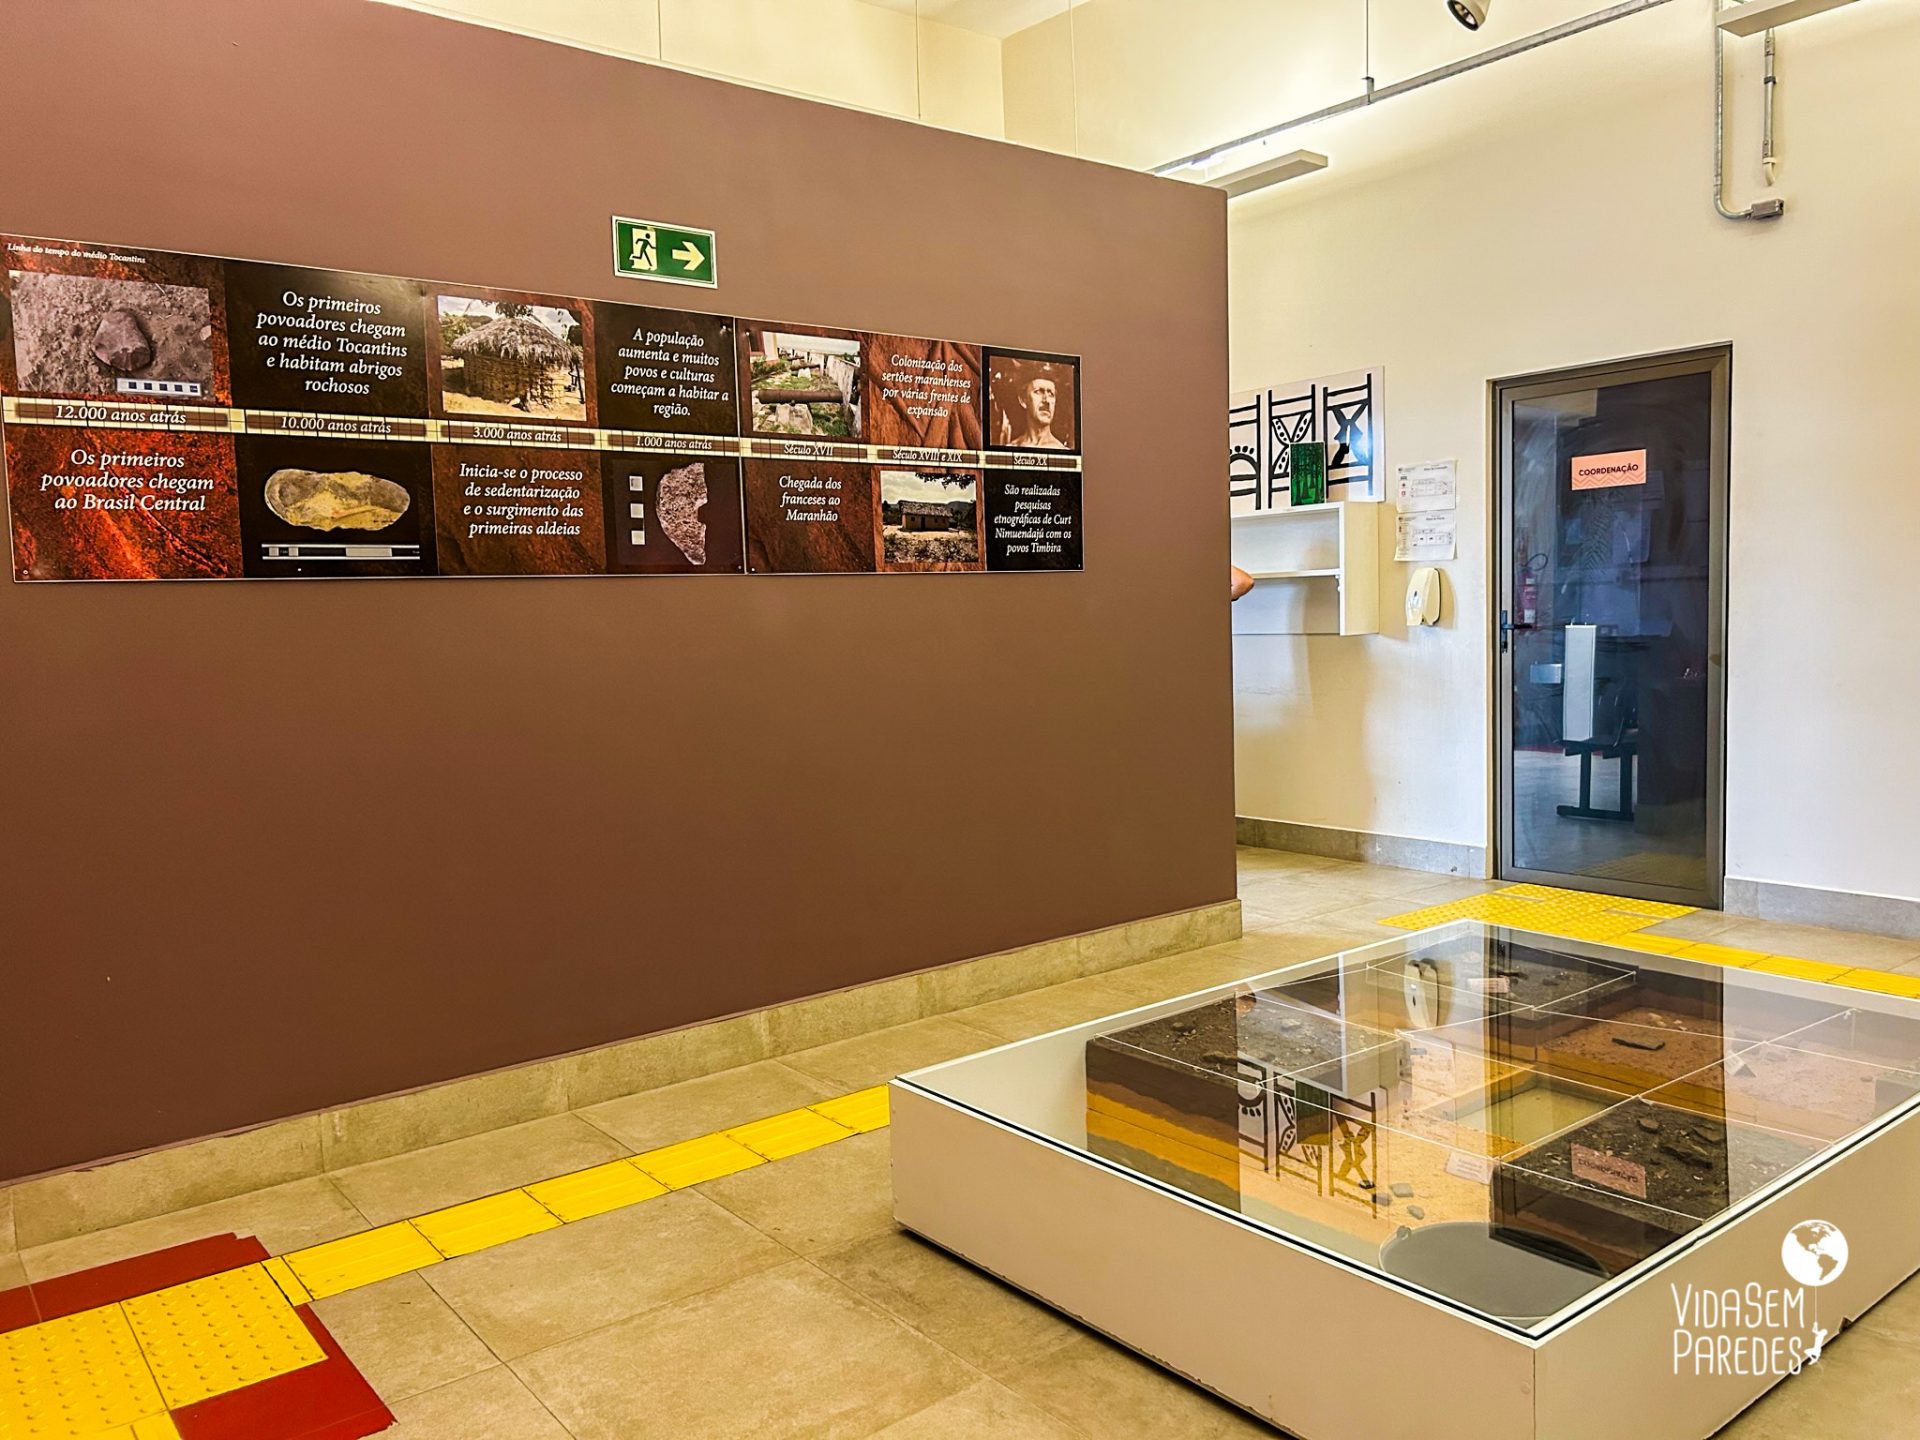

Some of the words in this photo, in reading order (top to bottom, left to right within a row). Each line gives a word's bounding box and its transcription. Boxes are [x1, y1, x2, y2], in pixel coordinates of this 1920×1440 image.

[7, 243, 31, 252] Linha
[33, 245, 44, 253] do
[45, 246, 70, 256] tempo
[71, 248, 82, 257] do
[83, 250, 107, 259] médio
[109, 252, 146, 264] Tocantins
[283, 291, 304, 307] Os
[307, 296, 381, 314] primeiros
[256, 312, 346, 332] povoadores
[350, 319, 406, 339] chegam
[258, 334, 278, 346] ao
[283, 334, 331, 351] médio
[337, 338, 408, 357] Tocantins
[633, 328, 642, 340] A
[645, 331, 704, 349] população
[618, 348, 670, 362] aumenta
[672, 353, 679, 362] e
[682, 352, 720, 366] muitos
[891, 354, 945, 372] Colonização
[948, 360, 962, 372] dos
[266, 356, 275, 367] e
[280, 353, 345, 372] habitam
[349, 359, 402, 380] abrigos
[624, 365, 658, 379] povos
[660, 369, 667, 378] e
[670, 368, 715, 383] culturas
[305, 378, 370, 394] rochosos
[882, 371, 912, 383] sertões
[915, 375, 971, 388] maranhenses
[611, 383, 665, 398] começam
[668, 388, 676, 397] a
[679, 385, 719, 400] habitar
[722, 392, 728, 401] a
[882, 388, 898, 400] por
[901, 388, 928, 400] várias
[928, 389, 958, 403] frentes
[960, 392, 970, 403] de
[56, 405, 107, 420] 12.000
[111, 411, 146, 422] anos
[150, 410, 187, 425] atrás
[653, 403, 690, 418] região.
[907, 406, 948, 418] expansão
[281, 416, 325, 430] 10.000
[328, 420, 357, 432] anos
[360, 420, 391, 434] atrás
[473, 427, 504, 438] 3.000
[507, 430, 532, 440] anos
[535, 430, 562, 442] atrás
[636, 436, 662, 447] 1.000
[665, 439, 686, 448] anos
[689, 439, 712, 450] atrás
[784, 444, 811, 455] Século
[813, 445, 833, 456] XVII
[71, 449, 95, 465] Os
[100, 452, 185, 468] primeiros
[893, 449, 917, 460] Século
[947, 453, 962, 462] XIX
[1014, 456, 1035, 465] Século
[1036, 457, 1048, 466] XX
[459, 463, 516, 478] Inicia-se
[520, 469, 528, 479] o
[530, 468, 583, 483] processo
[1579, 463, 1638, 476] COORDENAÇÃO
[41, 472, 144, 491] povoadores
[149, 477, 214, 494] chegam
[779, 476, 822, 492] Chegada
[825, 477, 842, 489] dos
[1005, 484, 1019, 495] São
[1021, 484, 1060, 496] realizadas
[465, 482, 481, 497] de
[484, 483, 580, 502] sedentarização
[780, 492, 826, 507] franceses
[828, 496, 840, 506] ao
[54, 496, 77, 510] ao
[83, 494, 135, 510] Brasil
[140, 495, 206, 511] Central
[1014, 500, 1051, 513] pesquisas
[463, 504, 471, 515] e
[474, 505, 483, 515] o
[486, 504, 559, 520] surgimento
[562, 504, 584, 517] das
[786, 509, 838, 521] Maranhão
[994, 513, 1041, 527] etnográficas
[1043, 514, 1052, 524] de
[1053, 515, 1072, 525] Curt
[468, 522, 533, 538] primeiras
[536, 522, 580, 535] aldeias
[1063, 531, 1072, 539] os
[1006, 544, 1029, 556] povos
[1031, 542, 1061, 553] Timbira
